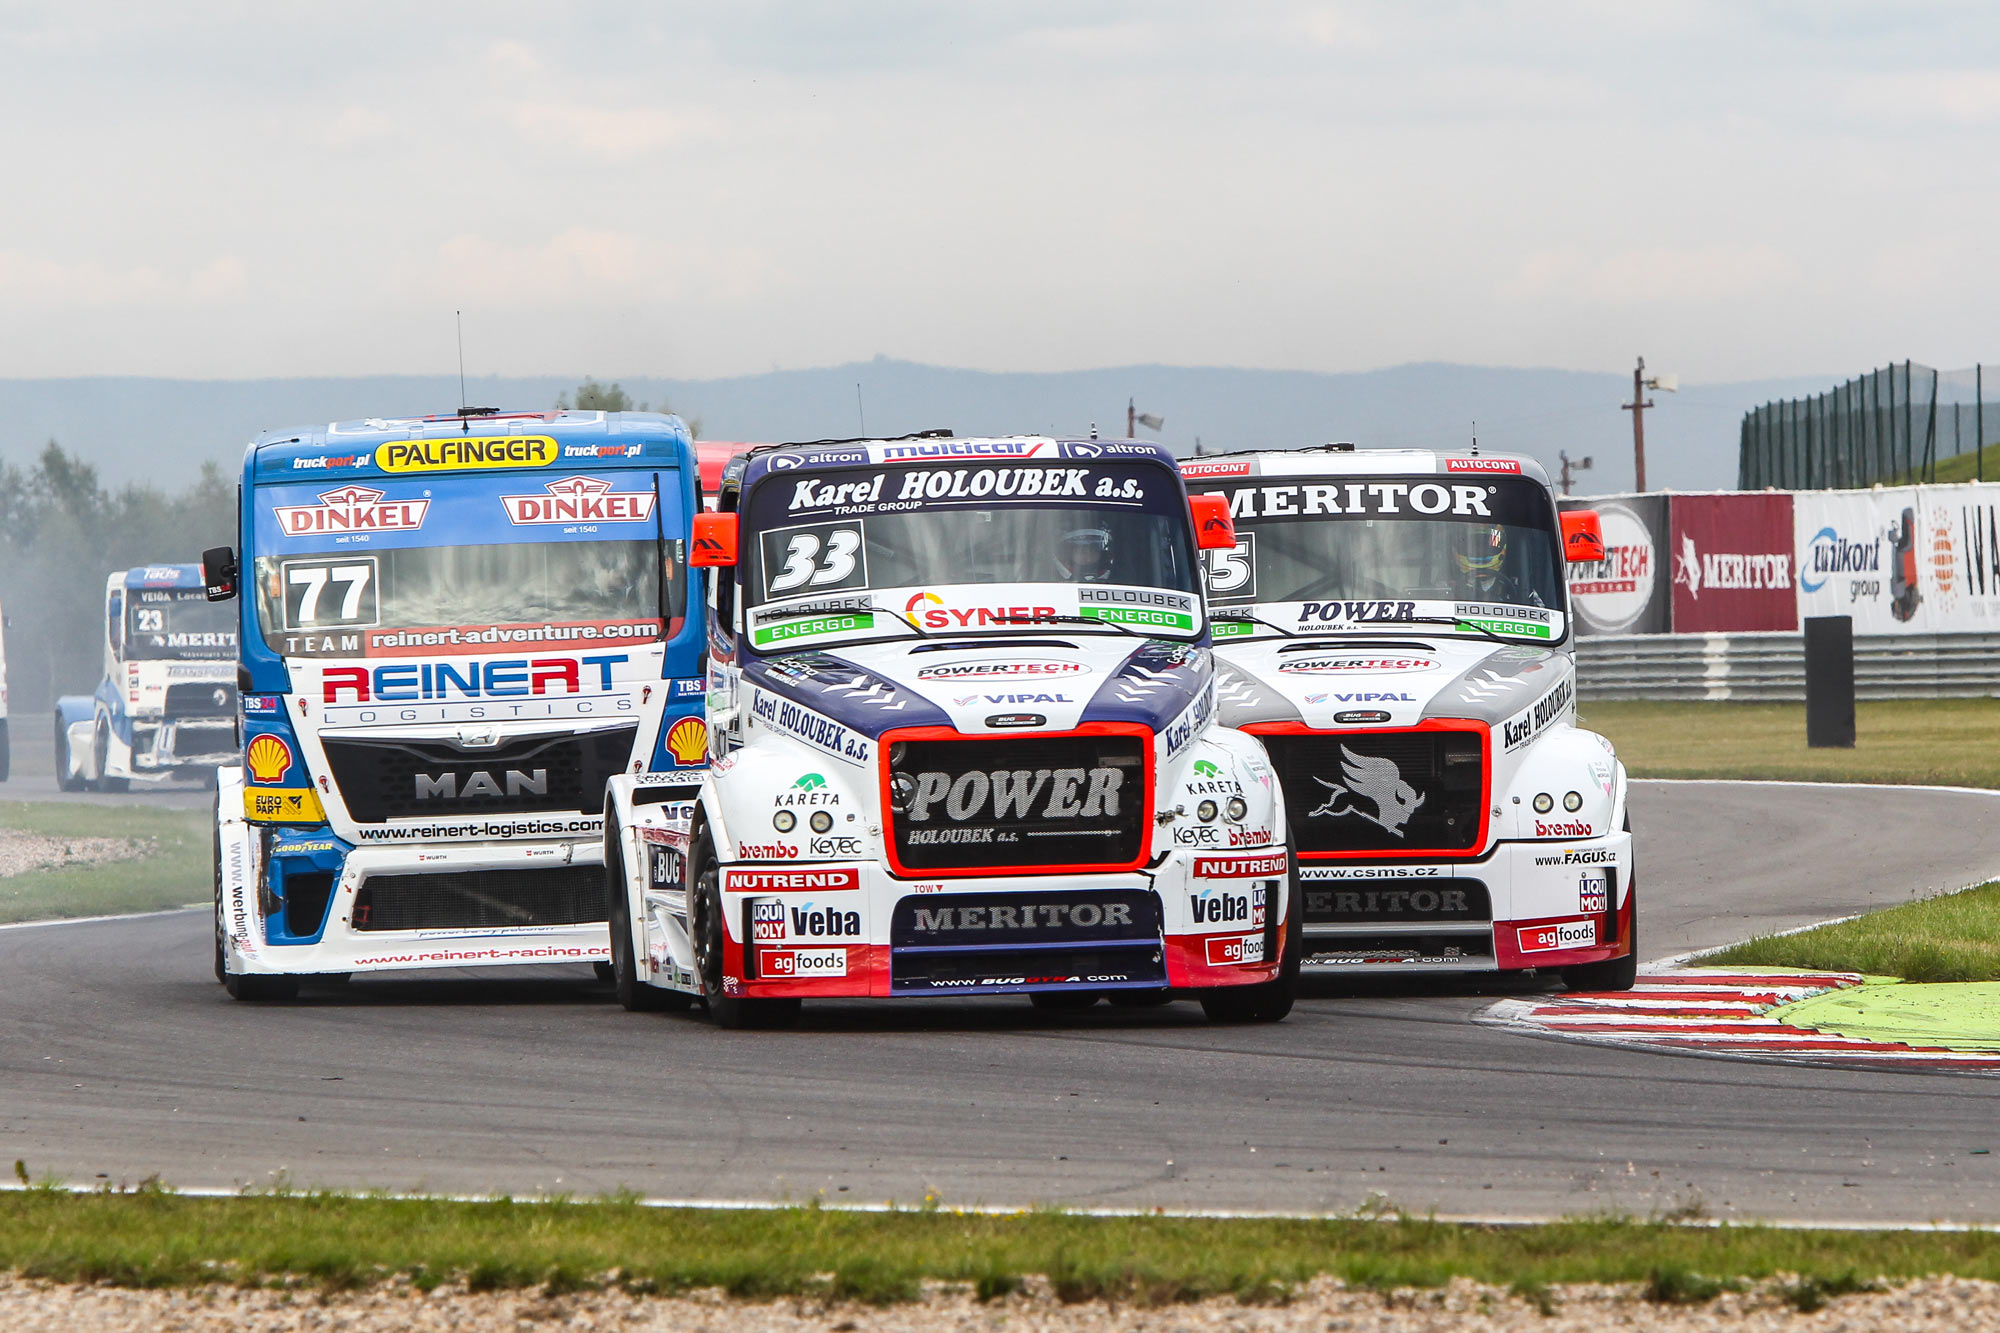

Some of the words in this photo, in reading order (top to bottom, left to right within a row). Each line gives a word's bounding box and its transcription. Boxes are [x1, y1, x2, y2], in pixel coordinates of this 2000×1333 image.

[388, 439, 546, 467] PALFINGER
[564, 444, 642, 458] truckport.pl
[808, 452, 862, 464] altron
[884, 442, 1026, 458] multicar
[1106, 444, 1157, 456] altron
[293, 454, 371, 470] truckport.pl
[1180, 464, 1246, 476] AUTOCONT
[1451, 460, 1516, 471] AUTOCONT
[788, 474, 886, 510] Karel
[898, 468, 1090, 501] HOLOUBEK
[1095, 476, 1144, 499] a.s.
[518, 497, 644, 521] DINKEL
[834, 503, 875, 516] TRADE
[878, 501, 922, 512] GROUP
[291, 506, 416, 531] DINKEL
[564, 526, 577, 534] seit
[579, 525, 597, 533] 1540
[351, 535, 369, 543] 1540
[769, 529, 861, 592] 33
[1814, 537, 1880, 573] unikont
[1200, 541, 1250, 592] 5
[1703, 553, 1791, 589] MERITOR
[289, 565, 370, 622] 77
[1080, 590, 1189, 610] HOLOUBEK
[1851, 581, 1880, 603] group
[138, 609, 163, 631] 23
[925, 607, 1056, 629] SYNER
[1098, 609, 1176, 625] ENERGO
[1298, 602, 1416, 622] POWER
[1457, 605, 1548, 623] HOLOUBEK
[371, 623, 658, 649] reinert-adventure.com
[772, 617, 855, 639] ENERGO
[1298, 624, 1344, 633] HOLOUBEK
[1470, 621, 1536, 635] ENERGO
[167, 632, 238, 648] MERIT
[286, 635, 358, 653] TEAM
[917, 663, 1080, 679] POWERTECH
[1279, 660, 1430, 672] POWERTECH
[322, 654, 629, 703] REINERT
[677, 680, 703, 693] TBS2
[245, 697, 276, 709] TBS24
[984, 692, 1074, 704] VIPAL
[1335, 692, 1416, 703] VIPAL
[324, 699, 632, 724] LOGISTICS
[753, 688, 776, 723] Karel
[779, 701, 846, 753] HOLOUBEK
[845, 738, 869, 762] a.s.
[1504, 710, 1532, 749] Karel
[1165, 712, 1190, 757] Karel
[415, 769, 547, 800] MAN
[1186, 780, 1244, 796] KARETA
[256, 795, 281, 805] EURO
[774, 793, 840, 807] KARETA
[908, 767, 1124, 821] POWER
[256, 805, 281, 815] PART
[359, 819, 604, 839] www.reinert-logistics.com
[908, 828, 995, 845] HOLOUBEK
[997, 832, 1019, 843] a.s.
[1228, 826, 1272, 847] brembo
[1535, 819, 1592, 836] brembo
[1173, 826, 1221, 848] KeyTec
[275, 842, 333, 854] GOODYEAR
[739, 841, 799, 859] brembo
[809, 837, 862, 857] KeyTec
[1201, 857, 1285, 875] NUTREND
[1535, 850, 1616, 867] www.FAGUS.cz
[729, 873, 849, 889] NUTREND
[1299, 866, 1438, 879] www.csms.cz
[914, 884, 934, 893] TOW
[1191, 889, 1248, 924] Veba
[1306, 889, 1468, 912] ERITOR
[754, 904, 783, 921] LIQUI
[791, 902, 860, 936] Veba
[914, 903, 1133, 932] MERITOR
[754, 922, 785, 939] MOLY
[355, 945, 608, 965] www.reinert-racing.co
